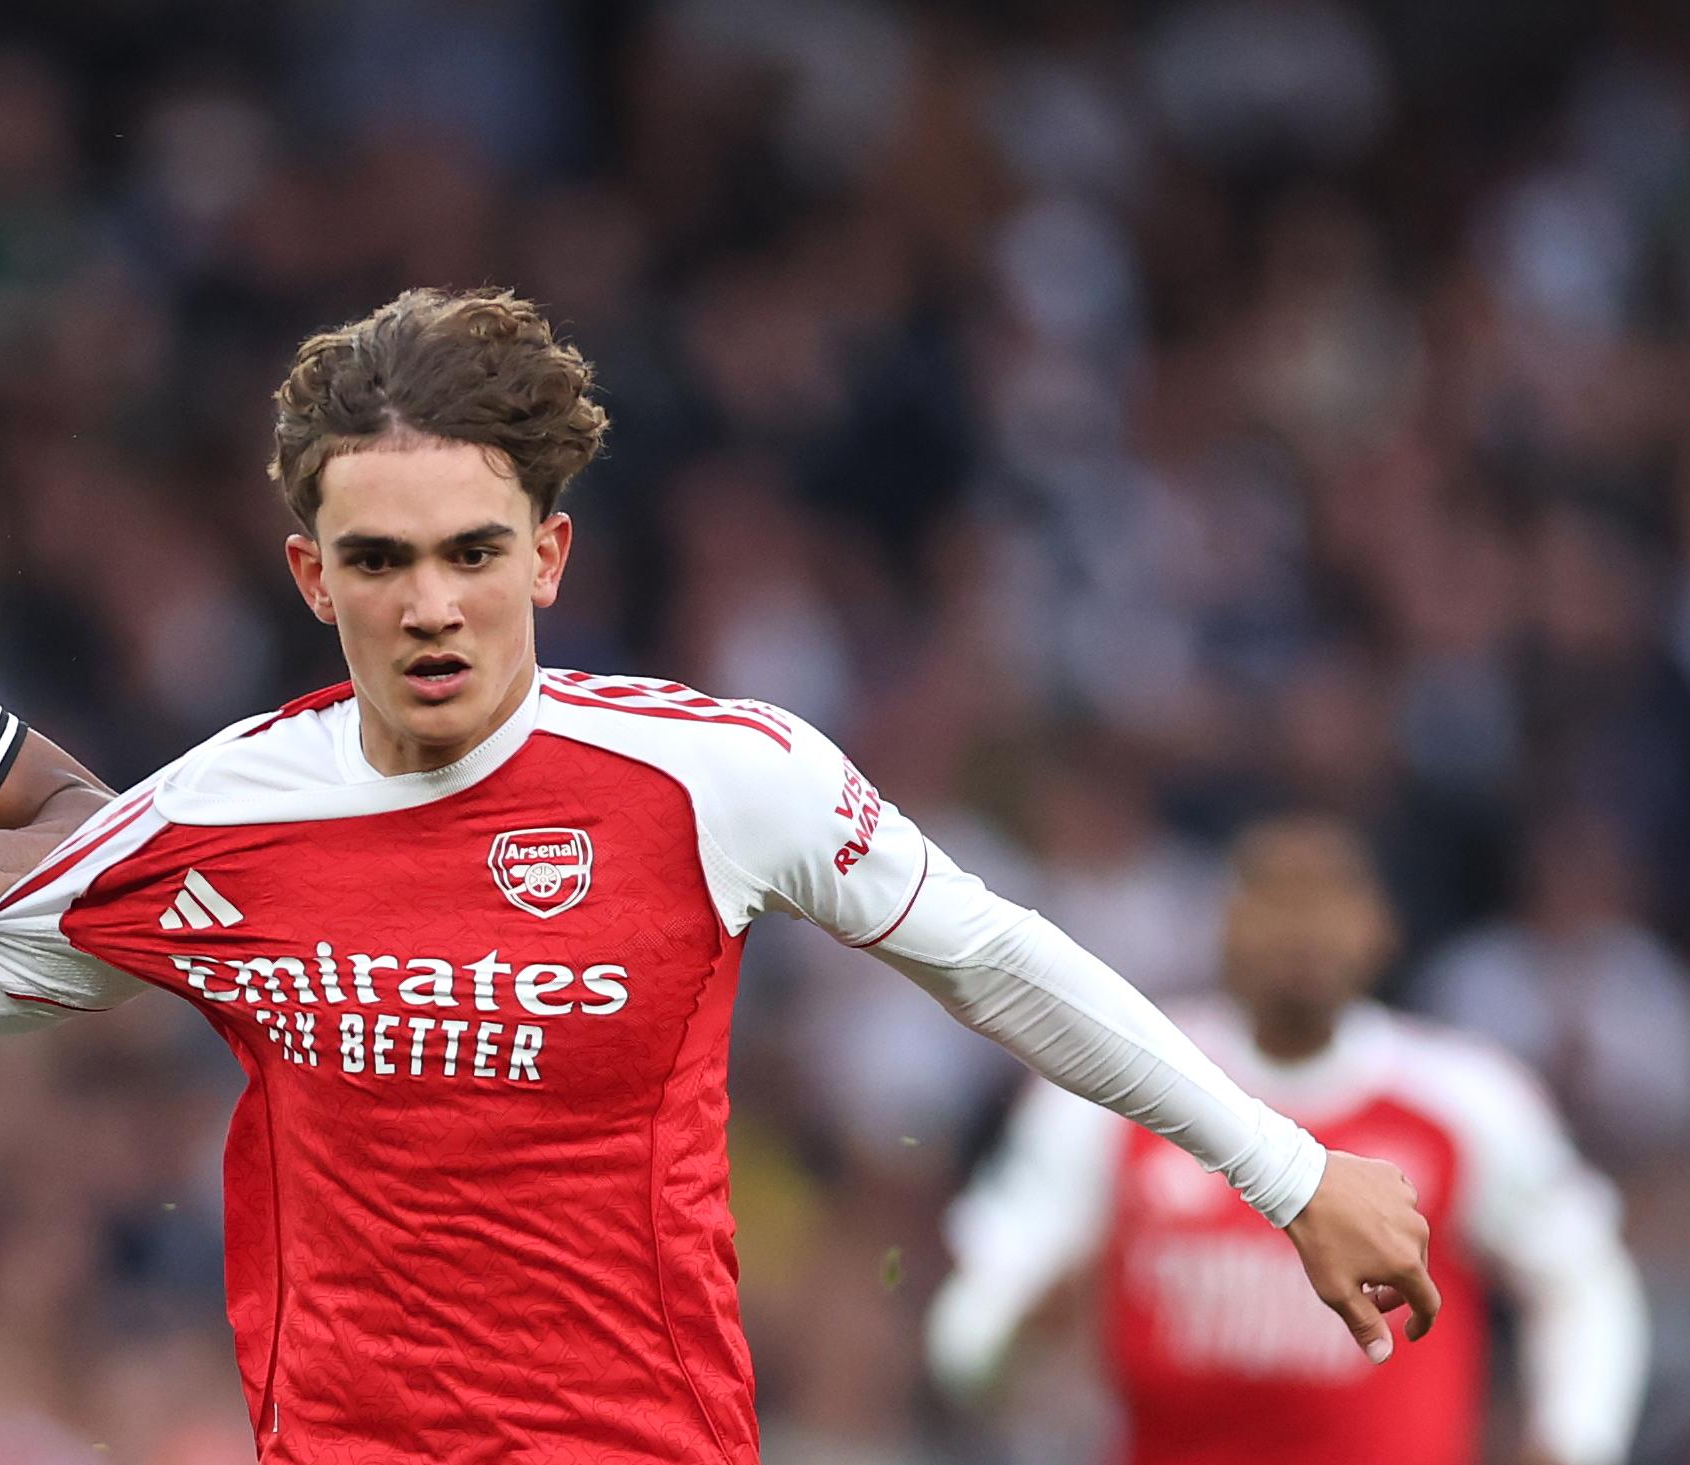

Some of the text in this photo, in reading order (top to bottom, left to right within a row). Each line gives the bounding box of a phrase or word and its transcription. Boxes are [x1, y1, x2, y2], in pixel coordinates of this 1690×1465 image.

[834, 755, 862, 820] VISI
[504, 839, 578, 860] Arsenal
[833, 789, 882, 876] RWAN
[167, 941, 629, 1016] Emirates
[338, 1012, 544, 1082] BETTER
